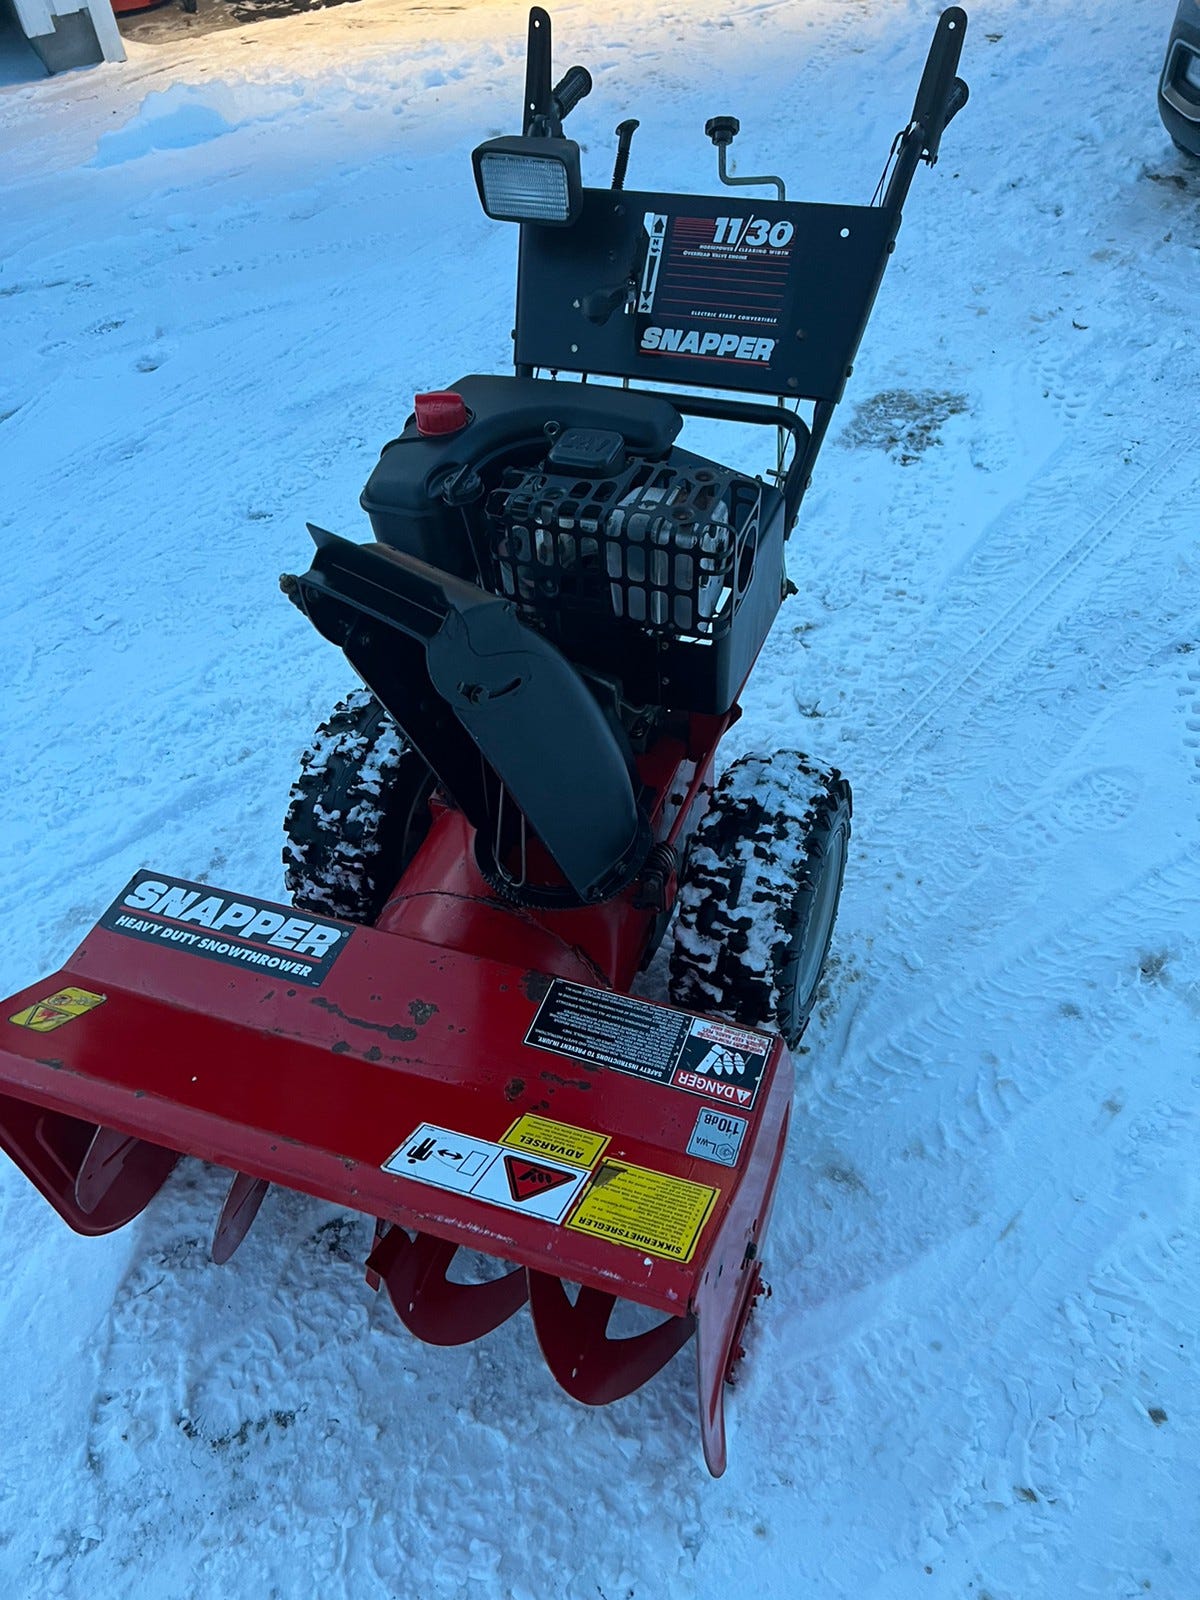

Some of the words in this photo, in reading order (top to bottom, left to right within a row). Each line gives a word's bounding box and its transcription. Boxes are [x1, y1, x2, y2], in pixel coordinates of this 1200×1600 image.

[713, 214, 794, 250] 11/30
[690, 310, 717, 318] ELECTRIC
[737, 314, 778, 324] CONVERTIBLE
[640, 326, 776, 361] SNAPPER
[123, 880, 341, 958] SNAPPER
[115, 914, 162, 937] HEAVY
[163, 926, 201, 948] DUTY
[197, 934, 313, 978] SNOWTHROWER
[559, 1042, 586, 1054] PREVENT
[595, 1052, 639, 1070] INSTRUCTIONS
[638, 1065, 663, 1077] SAFETY
[678, 1072, 735, 1098] DANGER
[518, 1134, 584, 1159] ADVARSEL
[577, 1216, 683, 1254] SIKKERHETSREGLER
